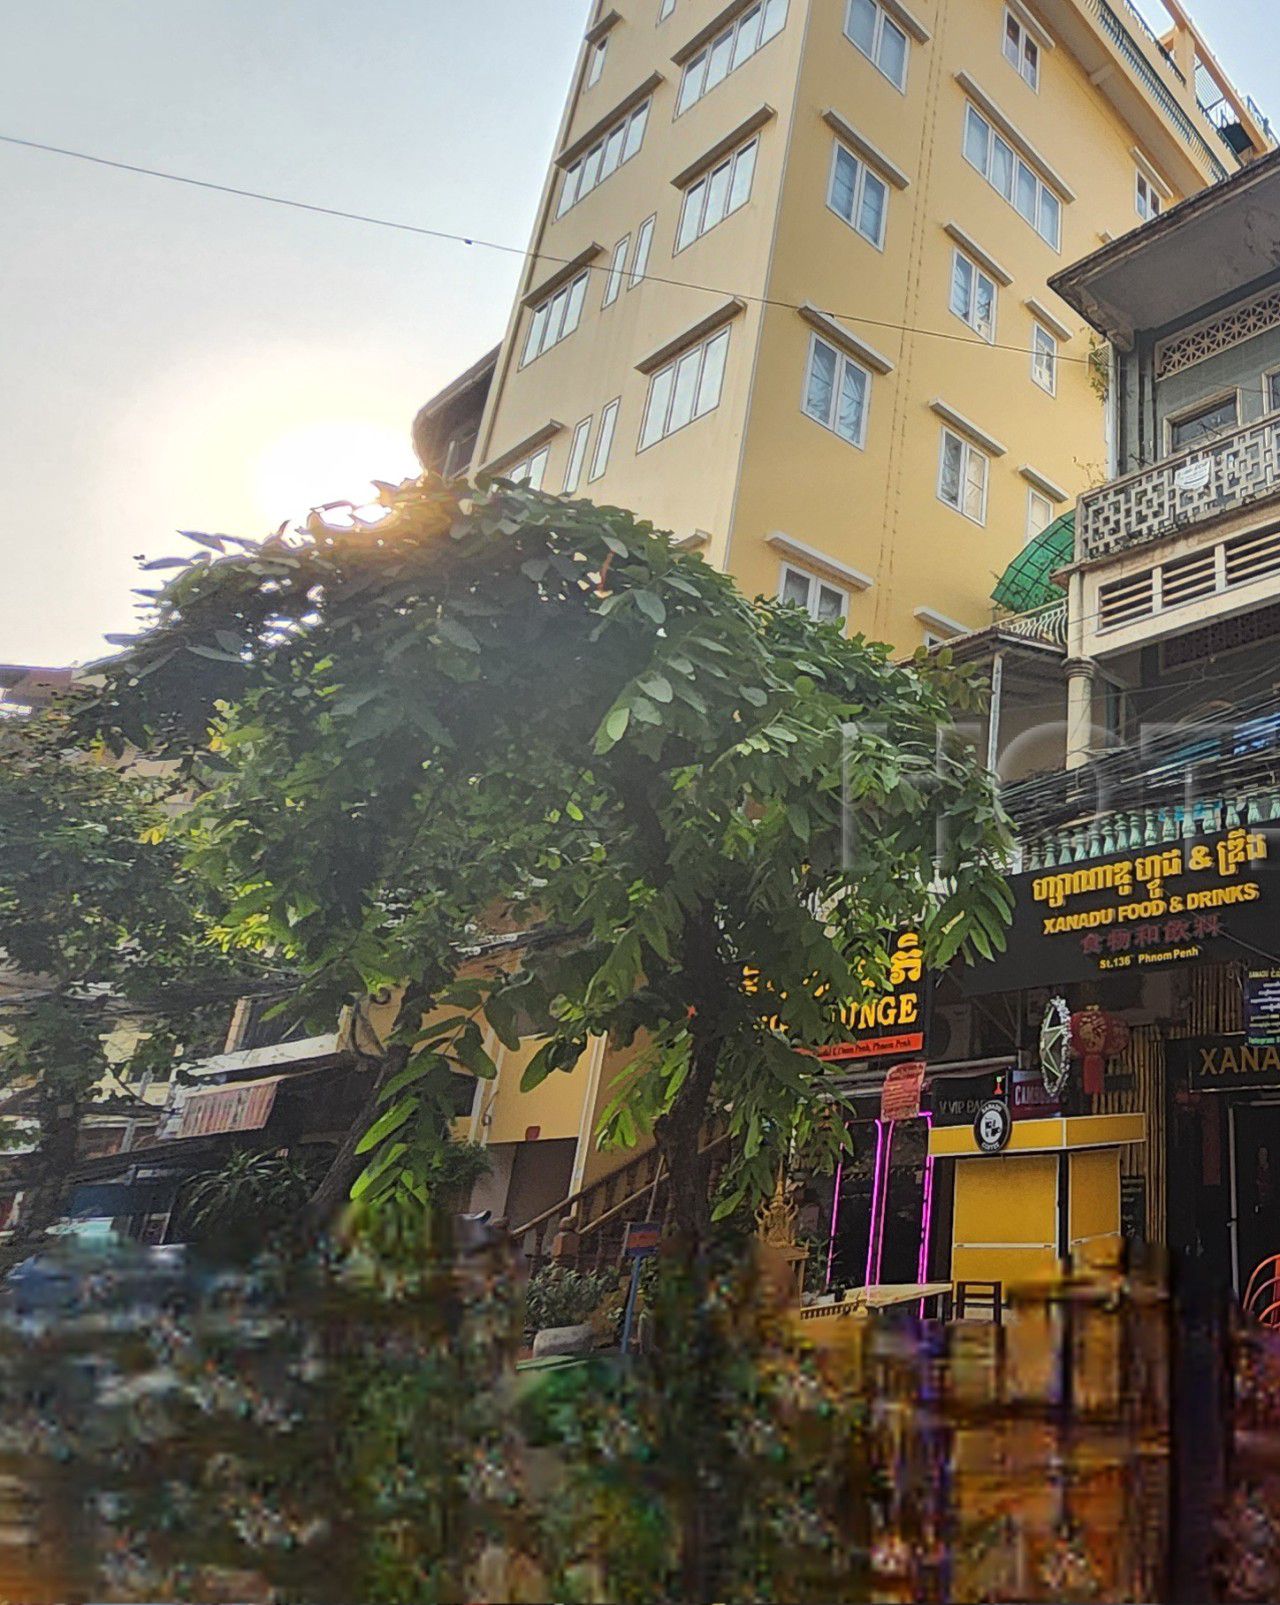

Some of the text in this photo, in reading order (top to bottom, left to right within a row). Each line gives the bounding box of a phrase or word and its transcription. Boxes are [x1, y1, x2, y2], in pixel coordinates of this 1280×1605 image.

[1188, 845, 1214, 871] &
[1043, 883, 1260, 935] XANADU FOOD & DRINKS
[1138, 952, 1172, 965] Phnom
[1173, 946, 1199, 960] Penh
